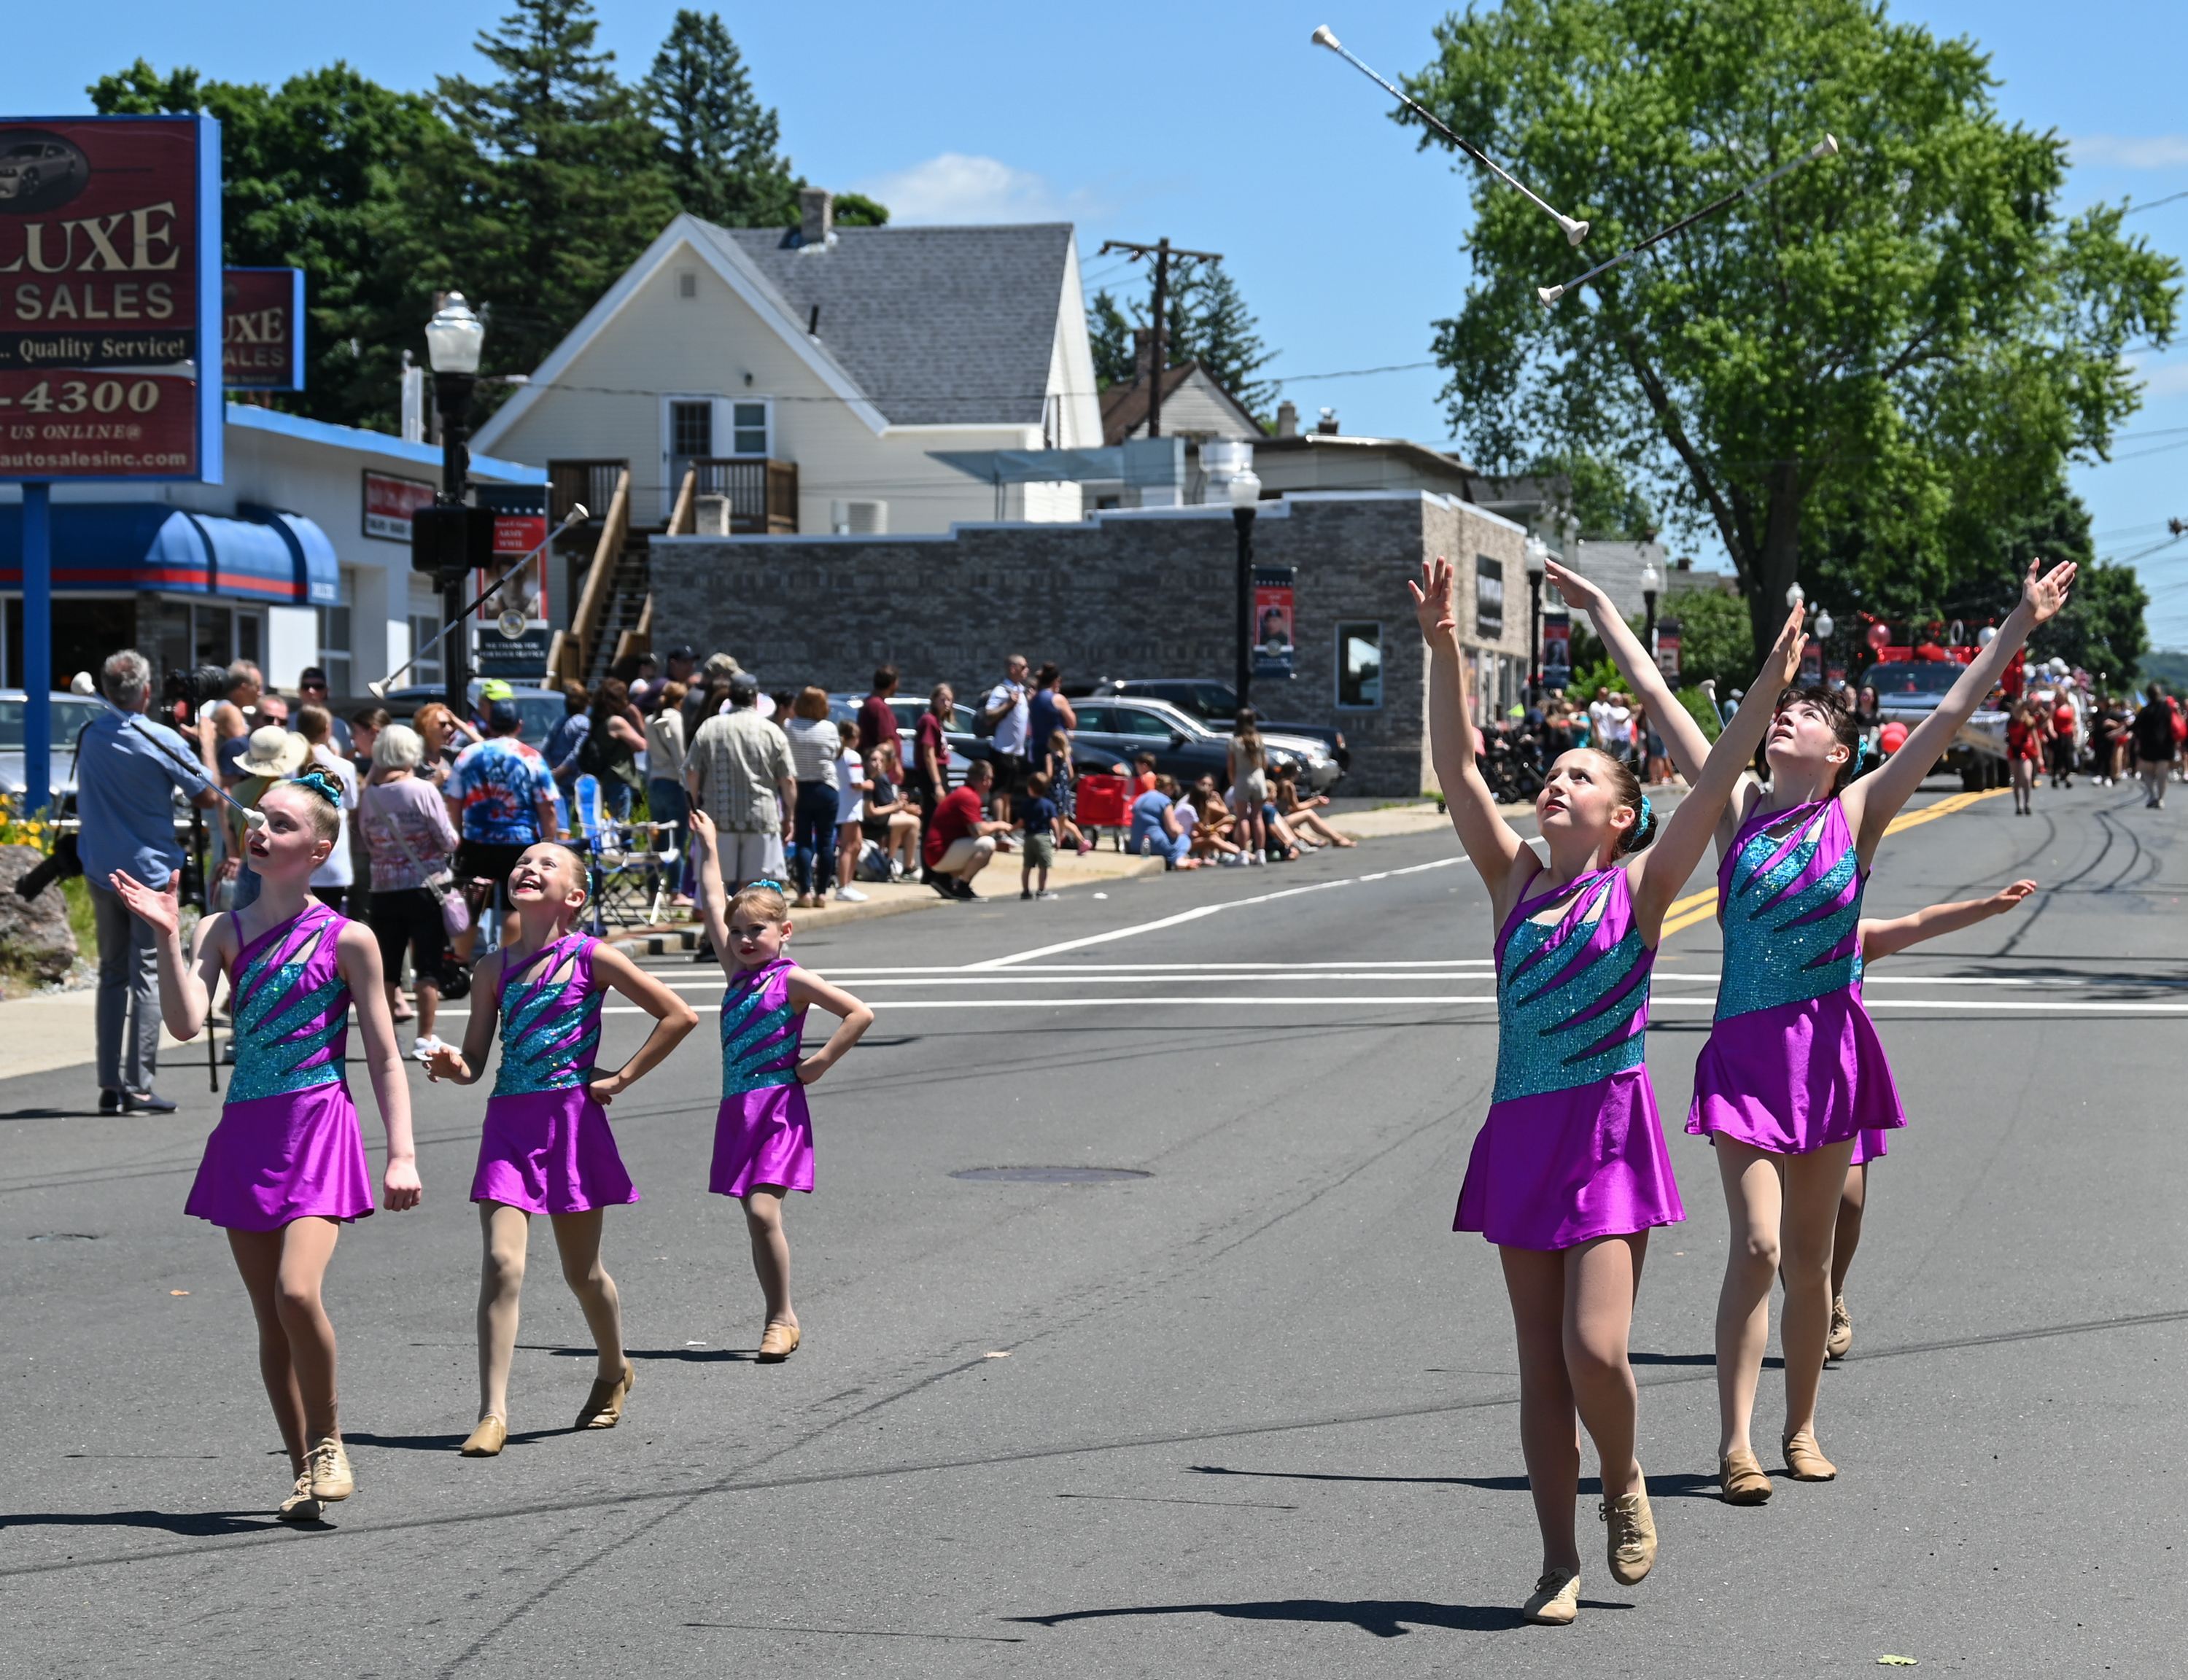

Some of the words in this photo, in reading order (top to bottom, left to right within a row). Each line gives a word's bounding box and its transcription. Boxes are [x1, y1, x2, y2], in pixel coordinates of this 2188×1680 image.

[15, 283, 174, 321] SALES
[19, 338, 94, 362] Quality
[101, 336, 185, 358] Service!
[10, 424, 35, 440] US
